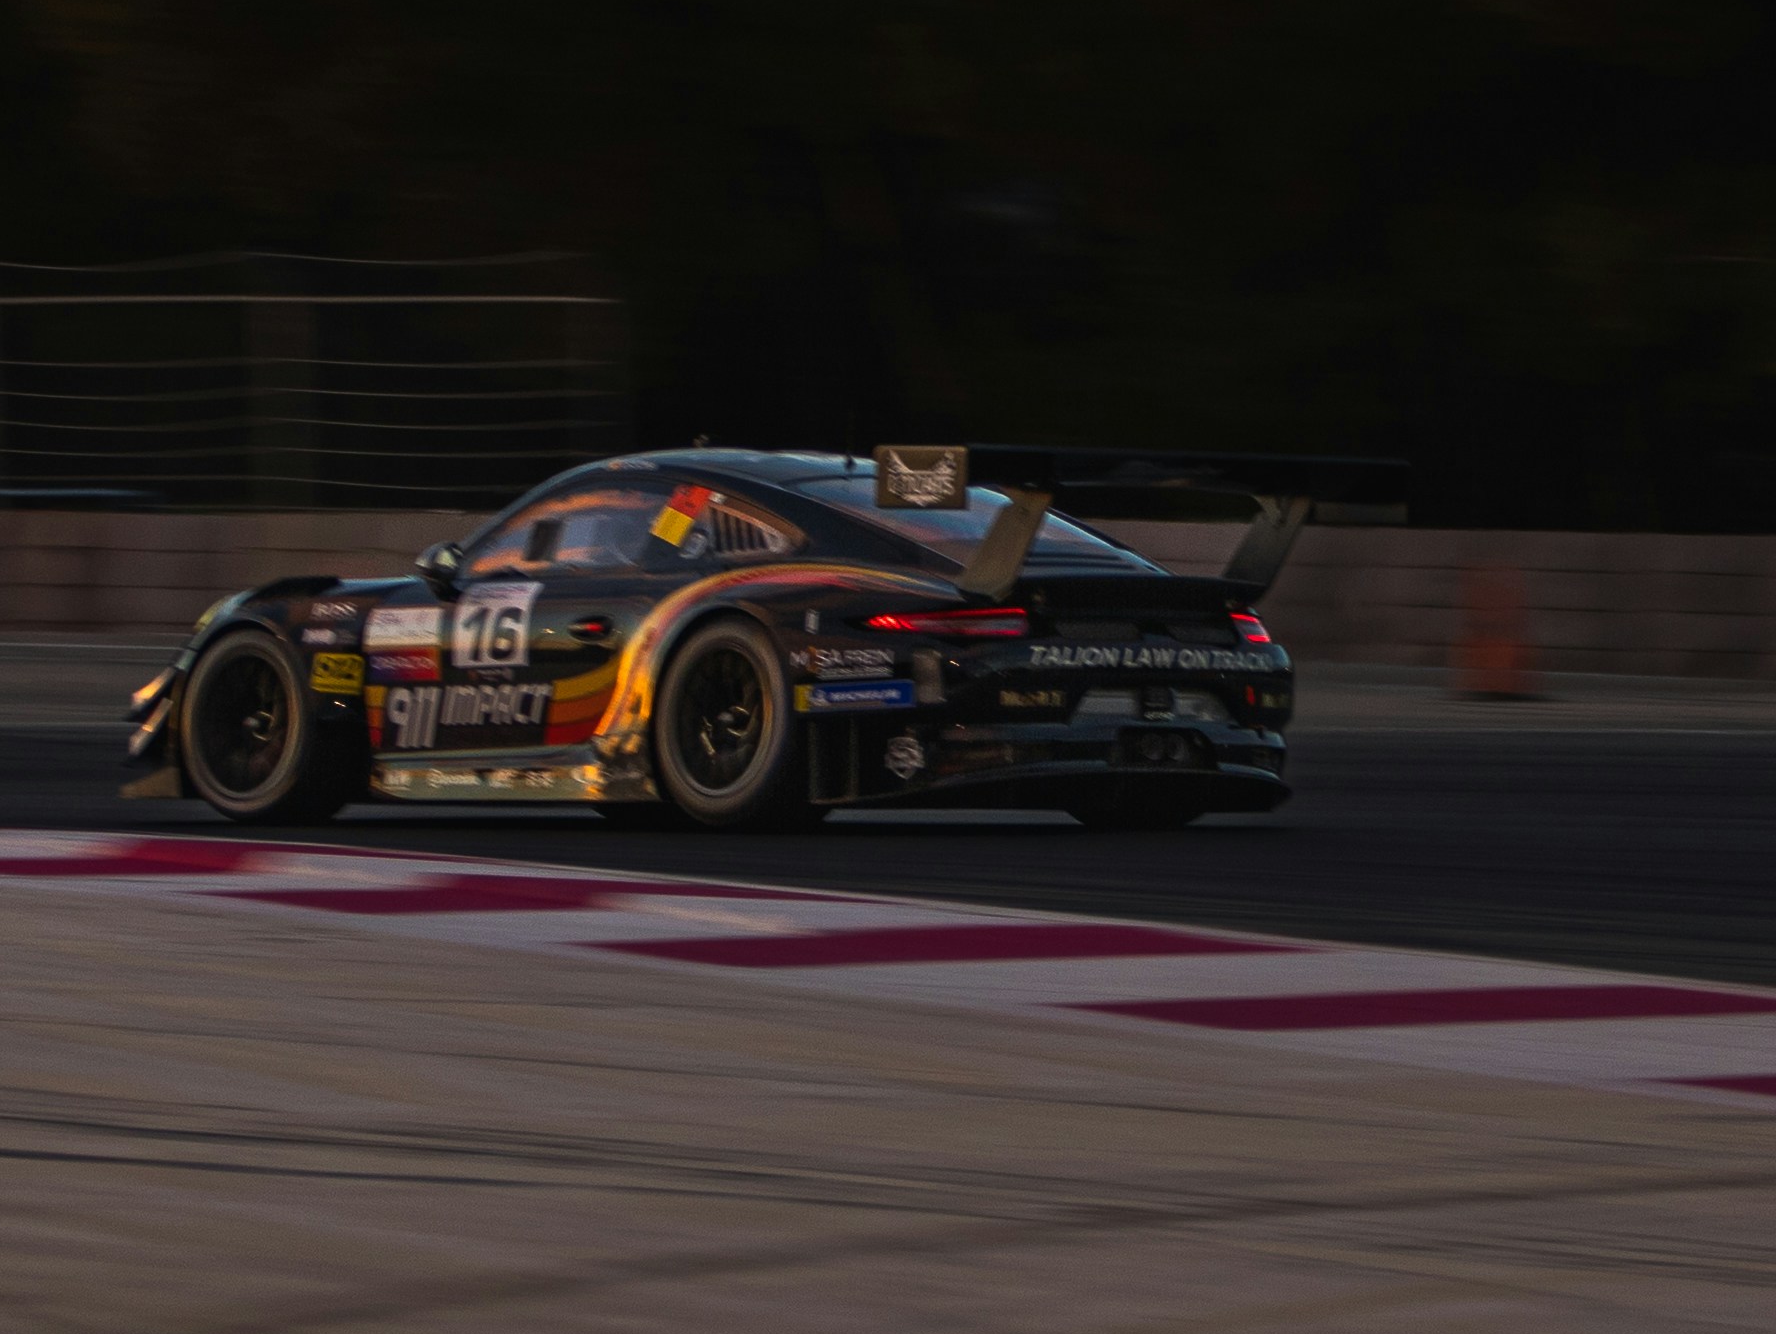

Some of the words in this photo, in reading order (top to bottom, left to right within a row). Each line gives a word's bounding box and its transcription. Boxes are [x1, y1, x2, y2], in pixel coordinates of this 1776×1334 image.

[462, 606, 525, 662] 16
[1029, 644, 1120, 667] TALION
[1123, 645, 1174, 668] LAW
[1177, 648, 1211, 668] ON
[386, 684, 443, 749] 911
[440, 683, 553, 727] IMPACT
